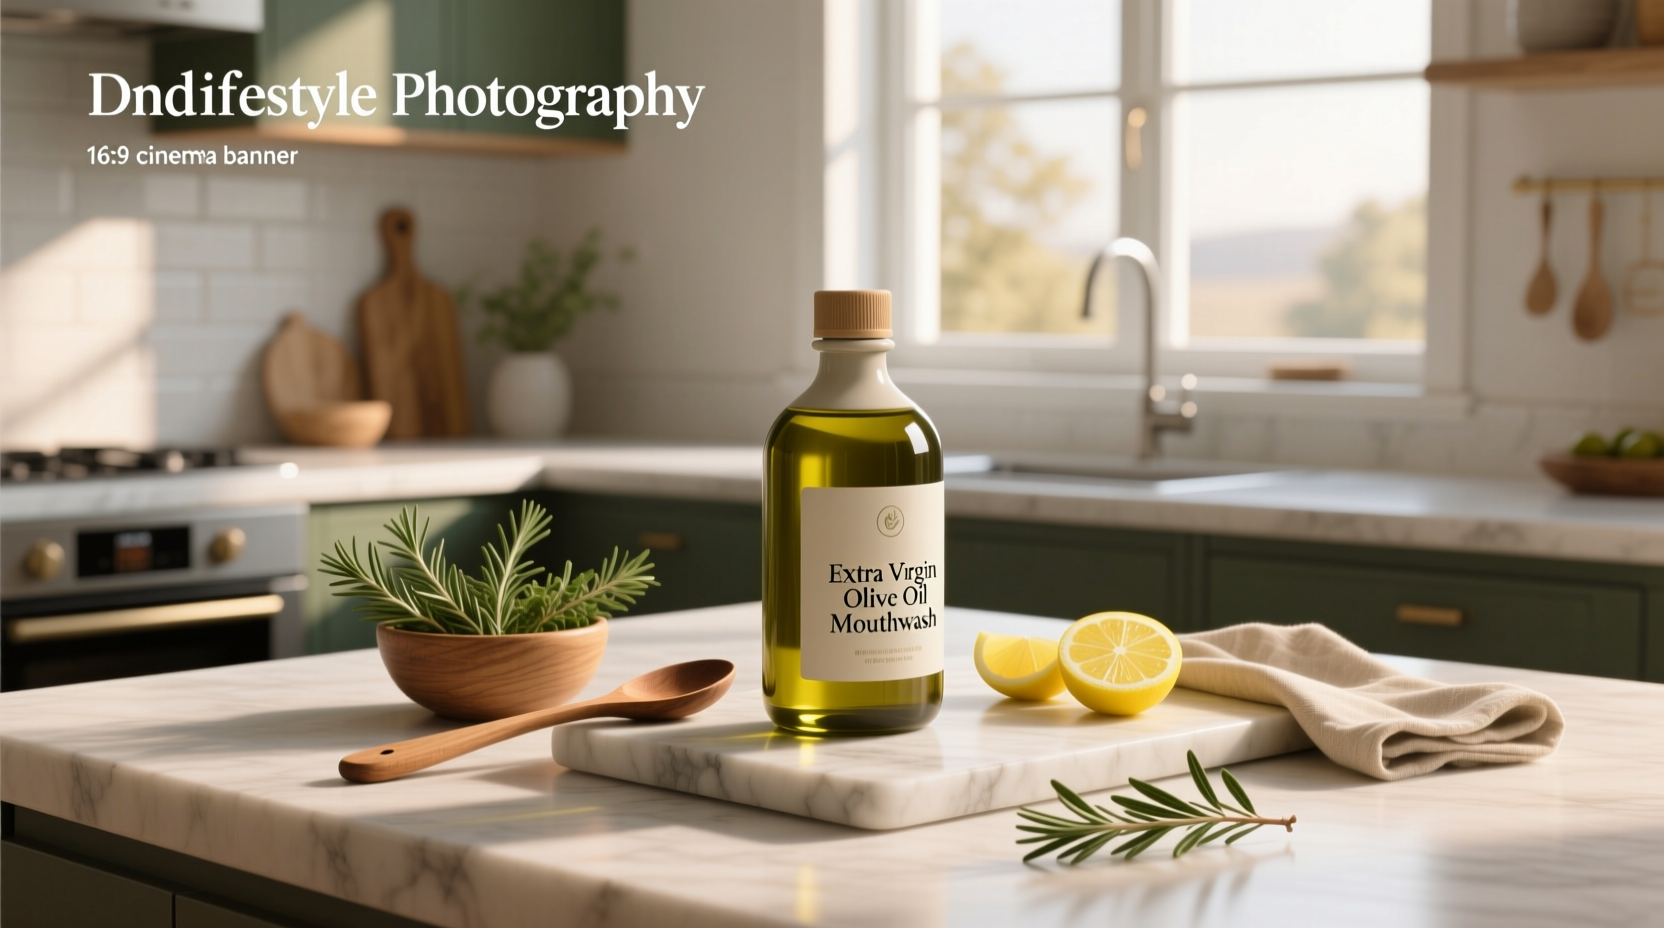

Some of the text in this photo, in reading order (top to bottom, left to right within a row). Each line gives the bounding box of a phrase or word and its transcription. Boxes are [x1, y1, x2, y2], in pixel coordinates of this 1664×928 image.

[828, 560, 937, 585] Extra Virgin
[843, 583, 928, 609] Olive Oil
[830, 606, 937, 634] Mouthwash
